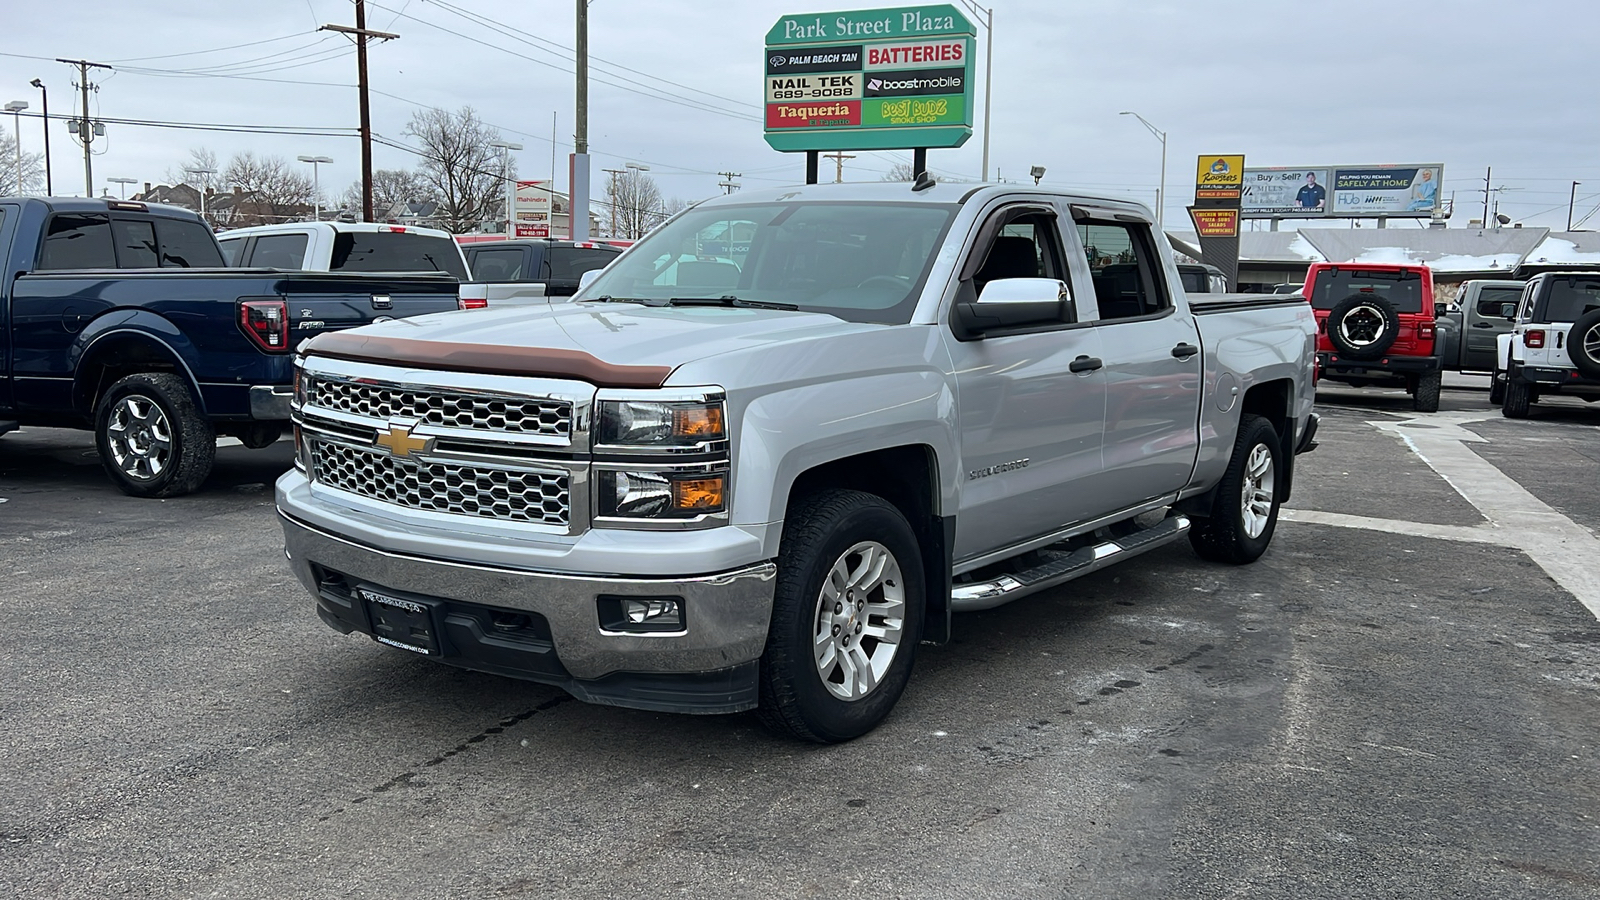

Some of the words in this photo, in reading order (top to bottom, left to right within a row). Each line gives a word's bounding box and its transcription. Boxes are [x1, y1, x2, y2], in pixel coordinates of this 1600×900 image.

[785, 18, 826, 38] Park
[836, 17, 891, 36] Street
[902, 11, 954, 32] Plaza
[789, 55, 811, 65] PALM
[812, 54, 840, 64] BEACH
[842, 52, 858, 63] TAN
[868, 44, 962, 64] BATTERIES
[772, 78, 810, 89] NAIL
[818, 76, 854, 87] TEK
[774, 88, 853, 99] 689-9088
[890, 116, 914, 124] SMOKE
[916, 116, 936, 124] SHOP
[1202, 172, 1238, 183] Roosters
[1257, 174, 1274, 182] Buy
[969, 457, 1030, 480] SILVERADO
